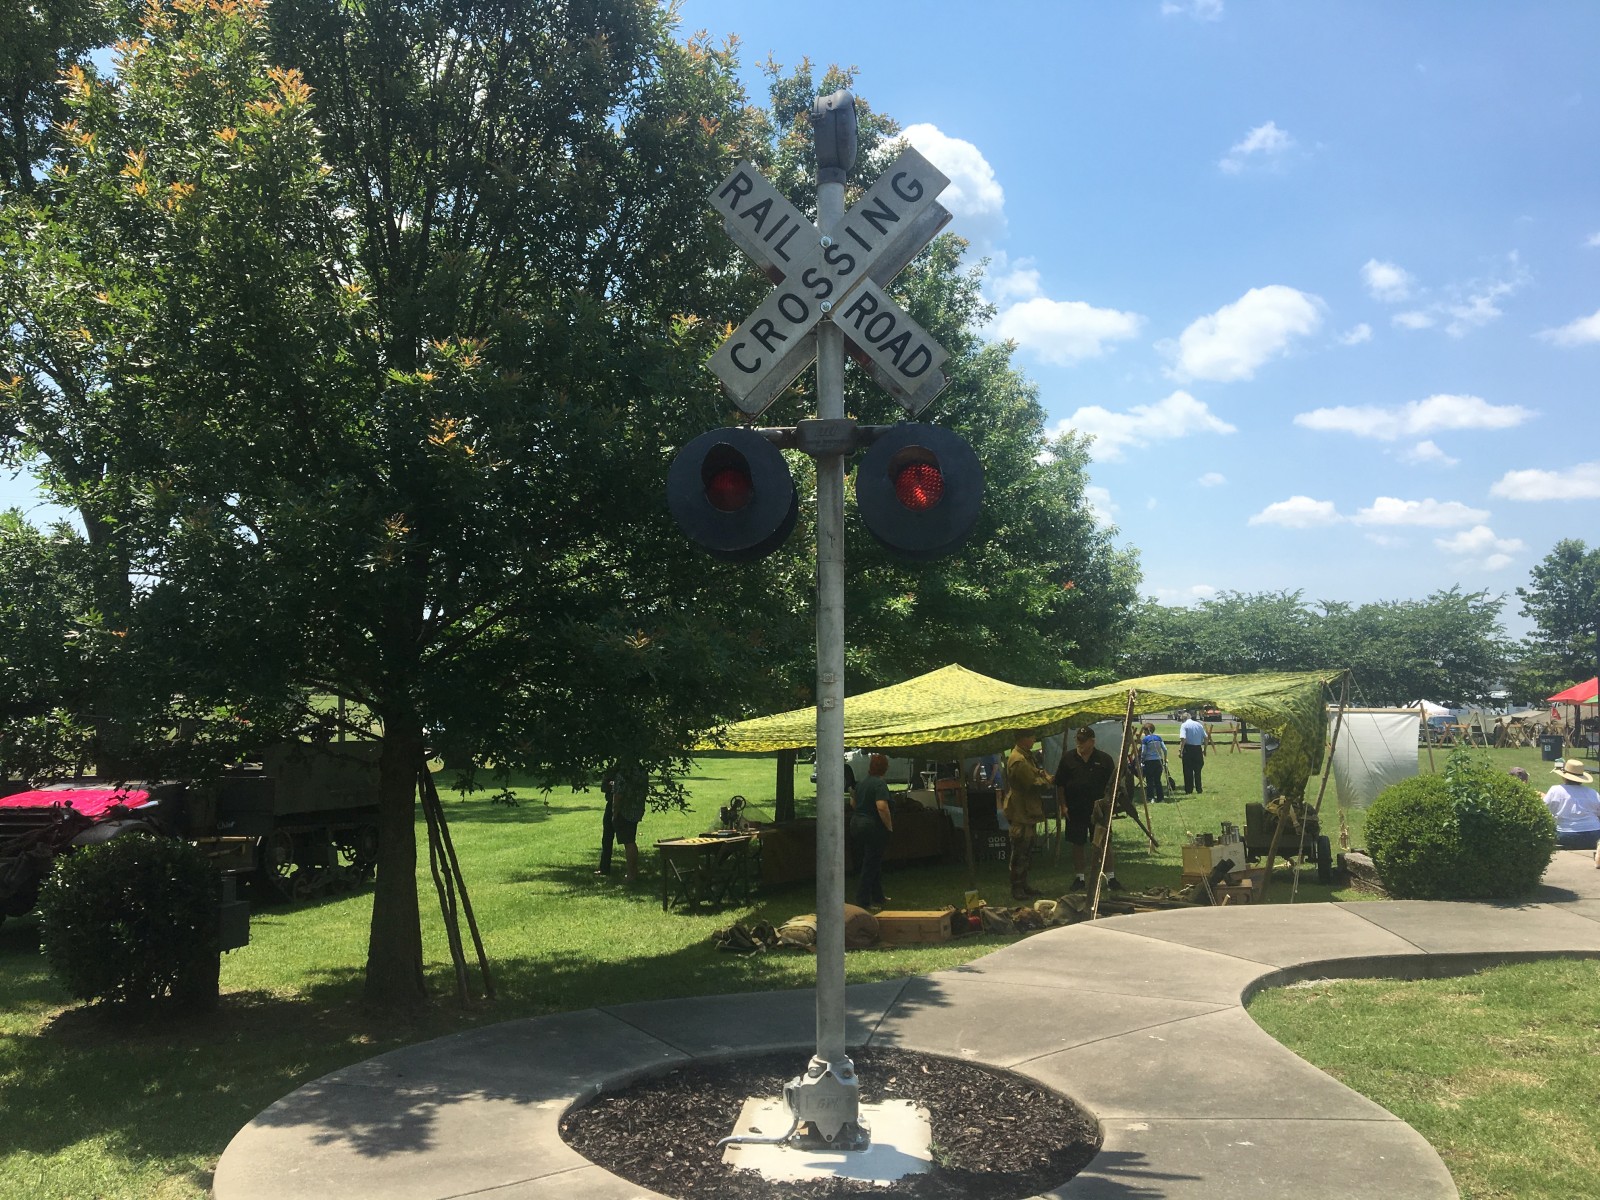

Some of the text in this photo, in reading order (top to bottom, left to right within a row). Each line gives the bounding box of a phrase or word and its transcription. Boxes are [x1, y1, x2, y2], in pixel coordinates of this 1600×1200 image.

[718, 171, 933, 378] RAIL ROAD
[730, 171, 924, 374] CROSSING
